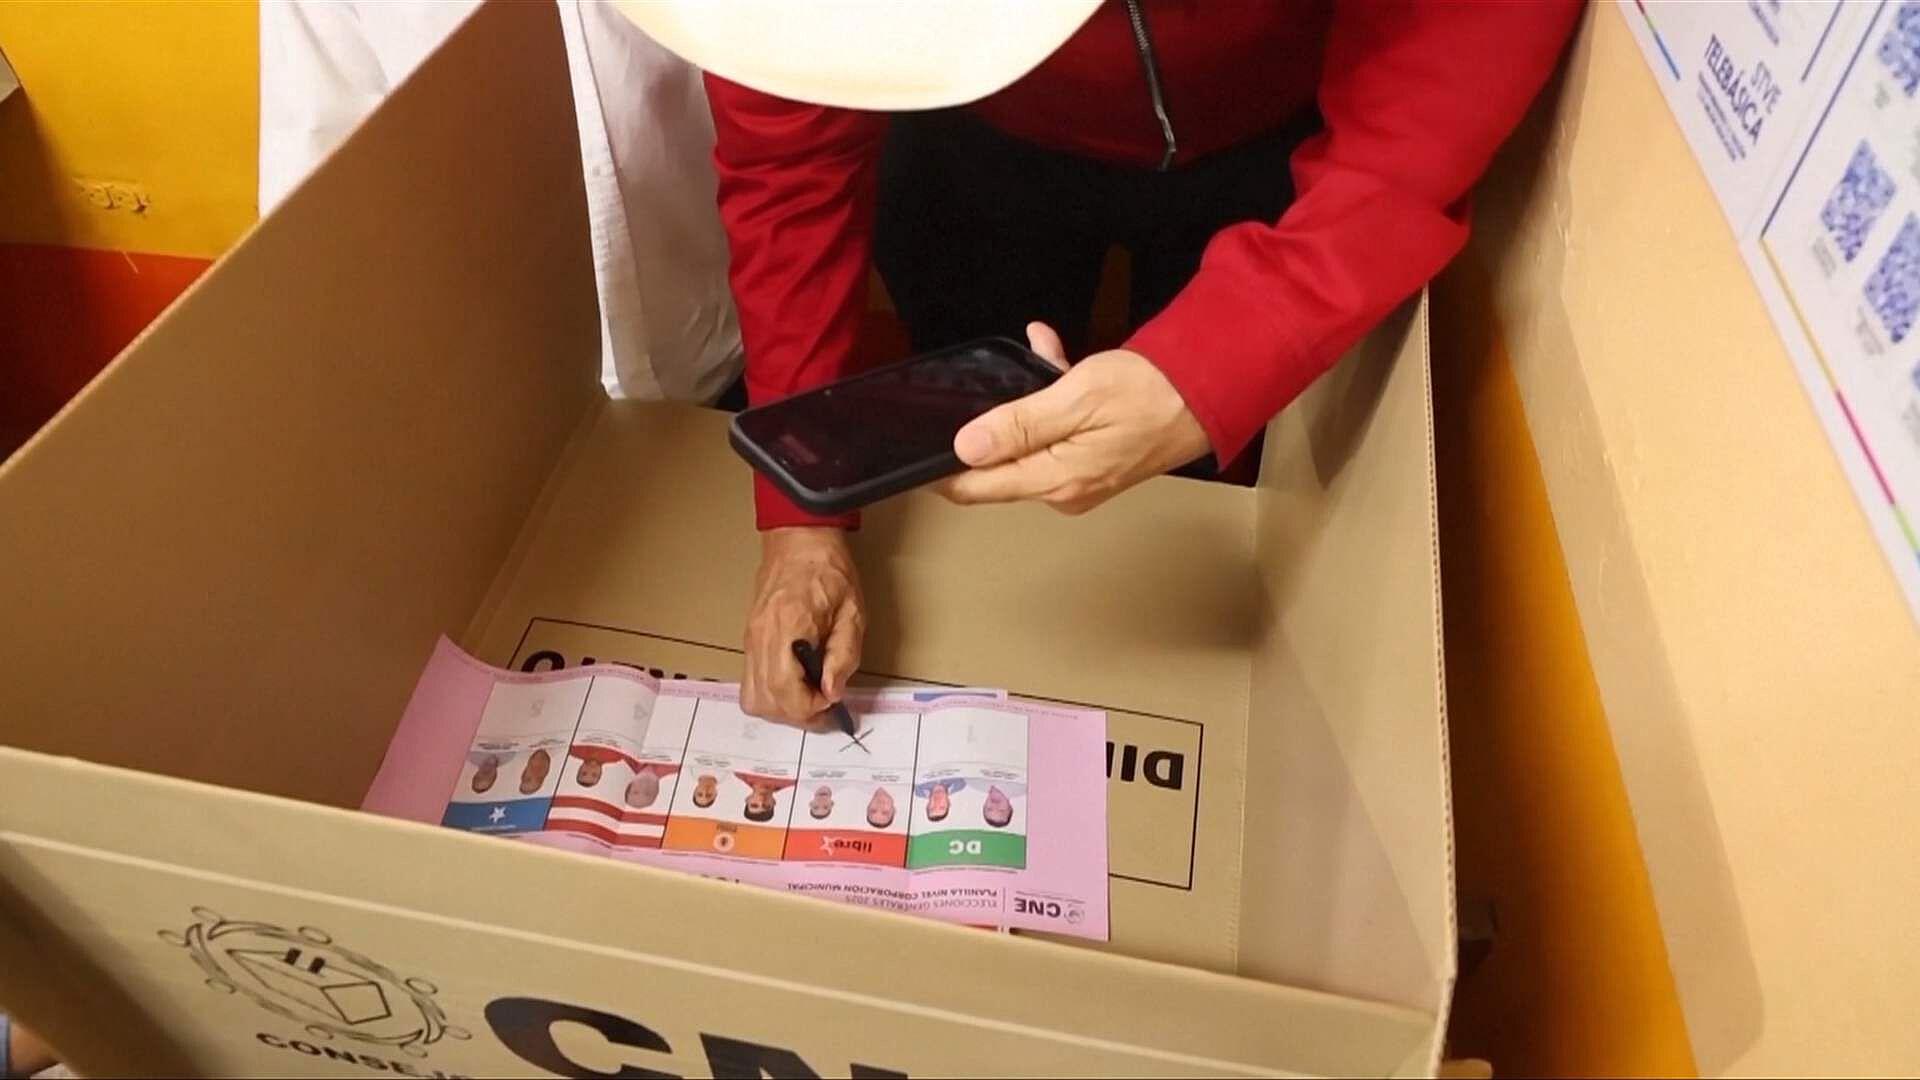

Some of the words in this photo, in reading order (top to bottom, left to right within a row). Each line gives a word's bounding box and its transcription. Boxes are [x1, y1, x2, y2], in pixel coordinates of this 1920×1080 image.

[1704, 33, 1763, 147] TELEBÁSICA
[833, 839, 873, 854] libre
[948, 839, 982, 855] DC
[788, 882, 841, 892] MUNICIPAL
[922, 889, 948, 900] NIVEL
[949, 887, 998, 898] PLANILLA
[1013, 896, 1062, 918] CNE
